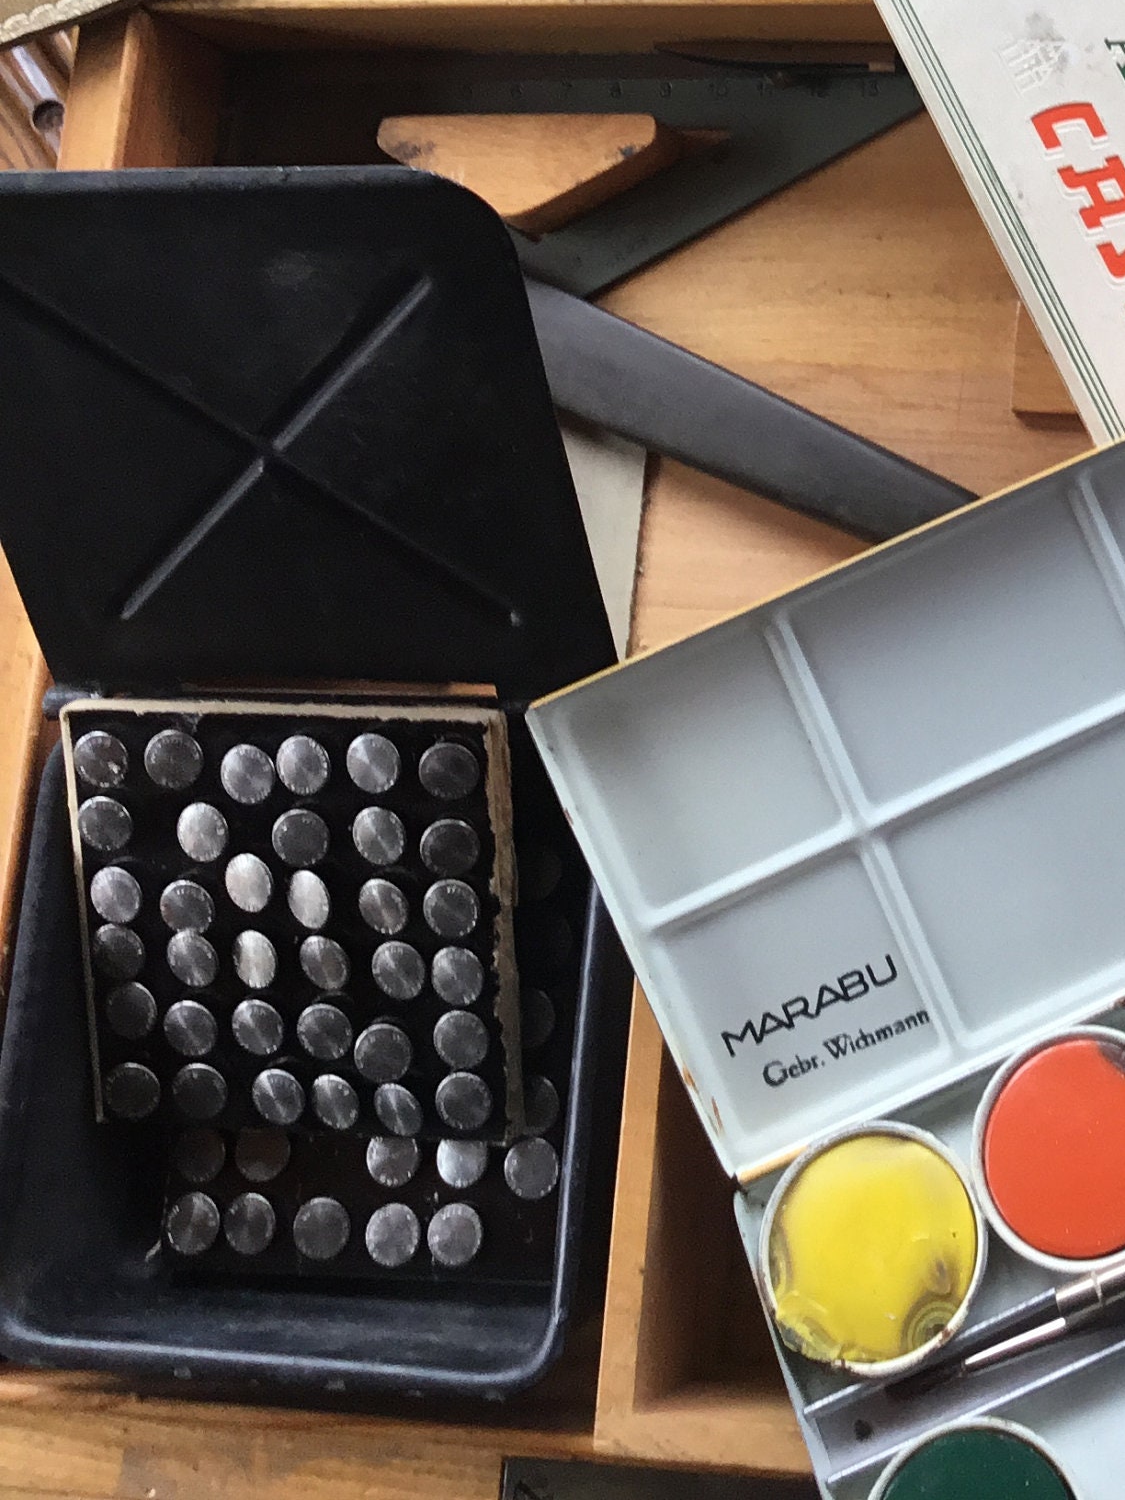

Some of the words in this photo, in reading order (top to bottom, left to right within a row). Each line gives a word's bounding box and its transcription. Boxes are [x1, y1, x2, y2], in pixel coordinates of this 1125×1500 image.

[720, 953, 899, 1058] MARABU
[762, 1053, 826, 1088] Gebr.
[822, 1007, 932, 1060] Wichmann
